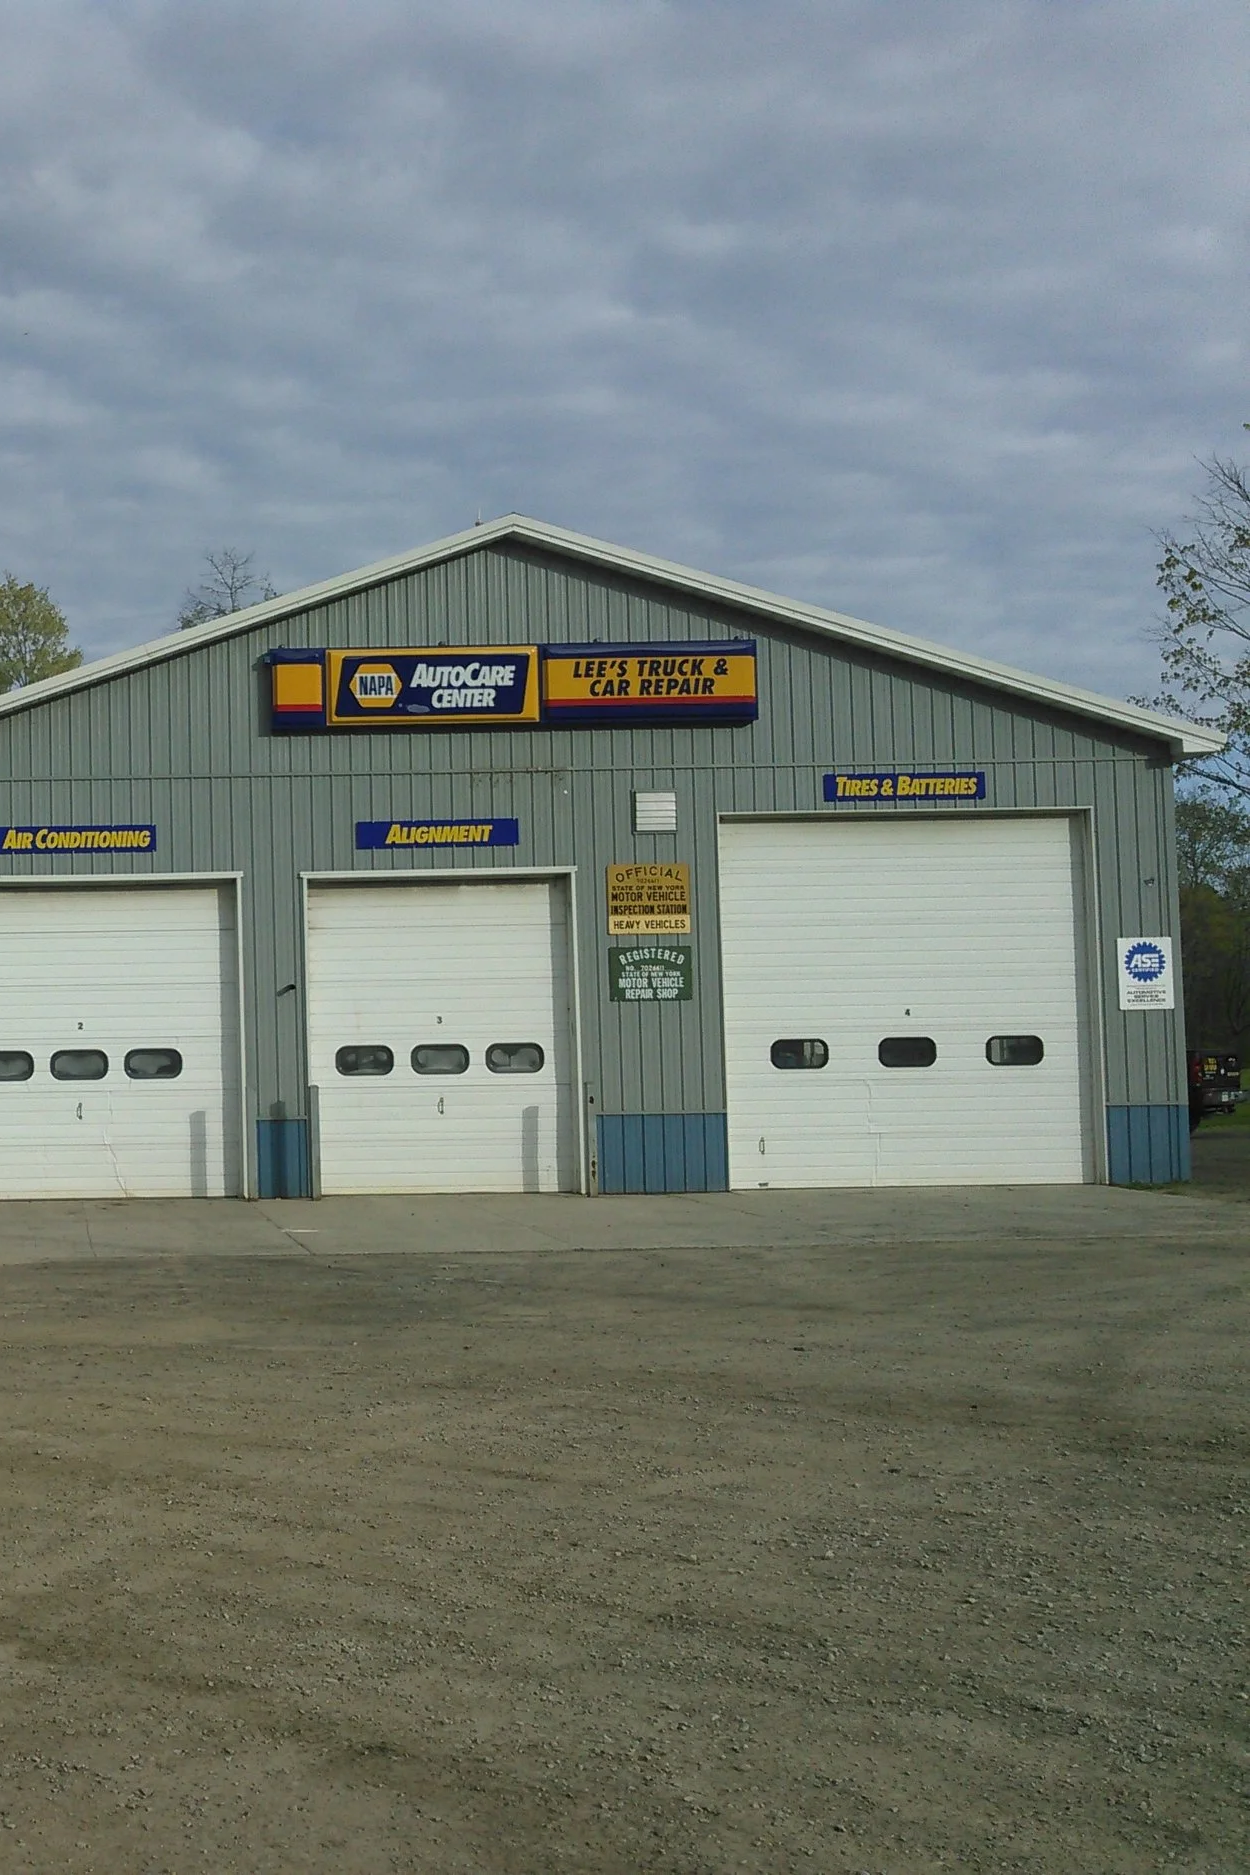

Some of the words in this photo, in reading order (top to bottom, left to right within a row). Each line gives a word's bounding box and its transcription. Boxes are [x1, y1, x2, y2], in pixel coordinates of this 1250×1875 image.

[410, 662, 516, 688] AUTOCARE
[573, 660, 628, 678] LEE'S
[637, 658, 704, 677] TRUCK
[713, 658, 729, 676] &
[359, 675, 394, 696] NAPA
[589, 679, 630, 697] CAR
[638, 678, 715, 696] REPAIR
[431, 688, 496, 708] CENTER
[836, 777, 878, 796] TIRES
[881, 778, 893, 795] &
[897, 776, 977, 796] BATTERIES
[2, 829, 33, 849] AIR
[35, 828, 151, 848] CONDITIONING
[385, 824, 493, 844] ALIGNMENT
[615, 866, 682, 882] OFFICIAL
[611, 892, 643, 902] MOTOR
[646, 891, 686, 901] VEHICLE
[610, 905, 655, 915] INSPECTION
[657, 904, 687, 914] STATION
[613, 920, 641, 930] HEAVY
[644, 919, 686, 929] VEHICLES
[619, 948, 685, 965] REGISTERED
[1130, 953, 1160, 968] ASE
[618, 978, 648, 988] MOTOR
[651, 977, 684, 988] VEHICLE
[625, 989, 653, 999] REPAIR
[656, 988, 679, 998] SHOP
[77, 1021, 84, 1030] 2
[436, 1015, 443, 1024] 3
